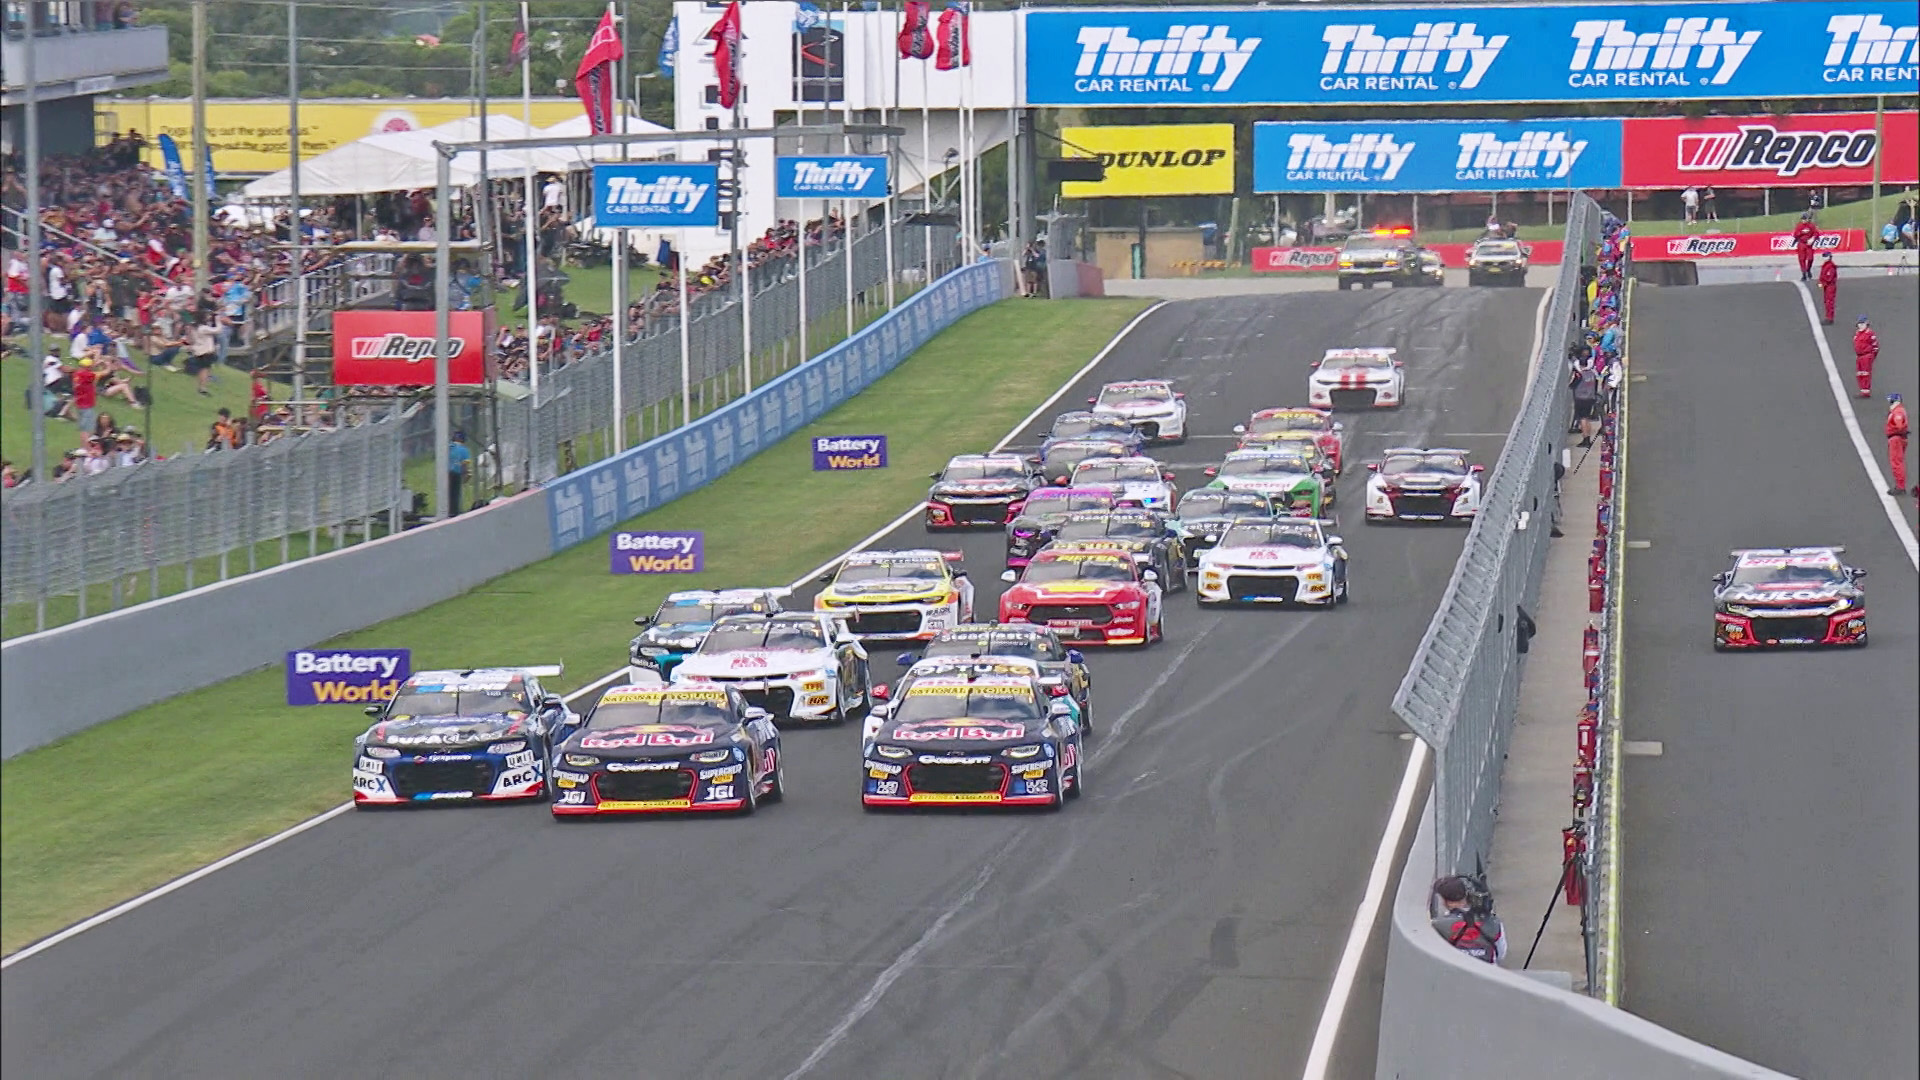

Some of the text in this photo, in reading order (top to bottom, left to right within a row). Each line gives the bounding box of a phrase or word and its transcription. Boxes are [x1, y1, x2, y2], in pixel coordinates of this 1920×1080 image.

[1074, 25, 1262, 92] Thrifty
[1320, 21, 1511, 89] Thrifty
[1569, 17, 1763, 85] Thrifty
[1320, 75, 1439, 90] CAR RENTAL
[1569, 72, 1690, 87] CAR RENTAL
[1823, 67, 1864, 82] CAR
[1074, 78, 1193, 93] CAR RENTAL
[1096, 149, 1226, 169] DUNLOP
[1287, 133, 1415, 181] Thrifty
[1456, 131, 1588, 178] Thrifty
[1732, 125, 1877, 177] Repco
[794, 161, 874, 190] Thrifty
[1286, 170, 1370, 181] CAR RENTAL
[1455, 169, 1540, 181] CAR RENTAL
[606, 175, 709, 213] Thrifty
[606, 204, 672, 214] CAR RENTAL
[1686, 237, 1737, 256] Repco
[1289, 249, 1335, 268] Repco
[817, 436, 880, 455] Battery
[827, 453, 880, 468] World
[616, 533, 695, 553] Battery
[629, 554, 695, 573] World
[295, 651, 399, 679] Battery
[313, 680, 397, 704] World
[648, 729, 714, 746] Bull
[959, 723, 1026, 739] Bull
[502, 764, 544, 788] ARCX
